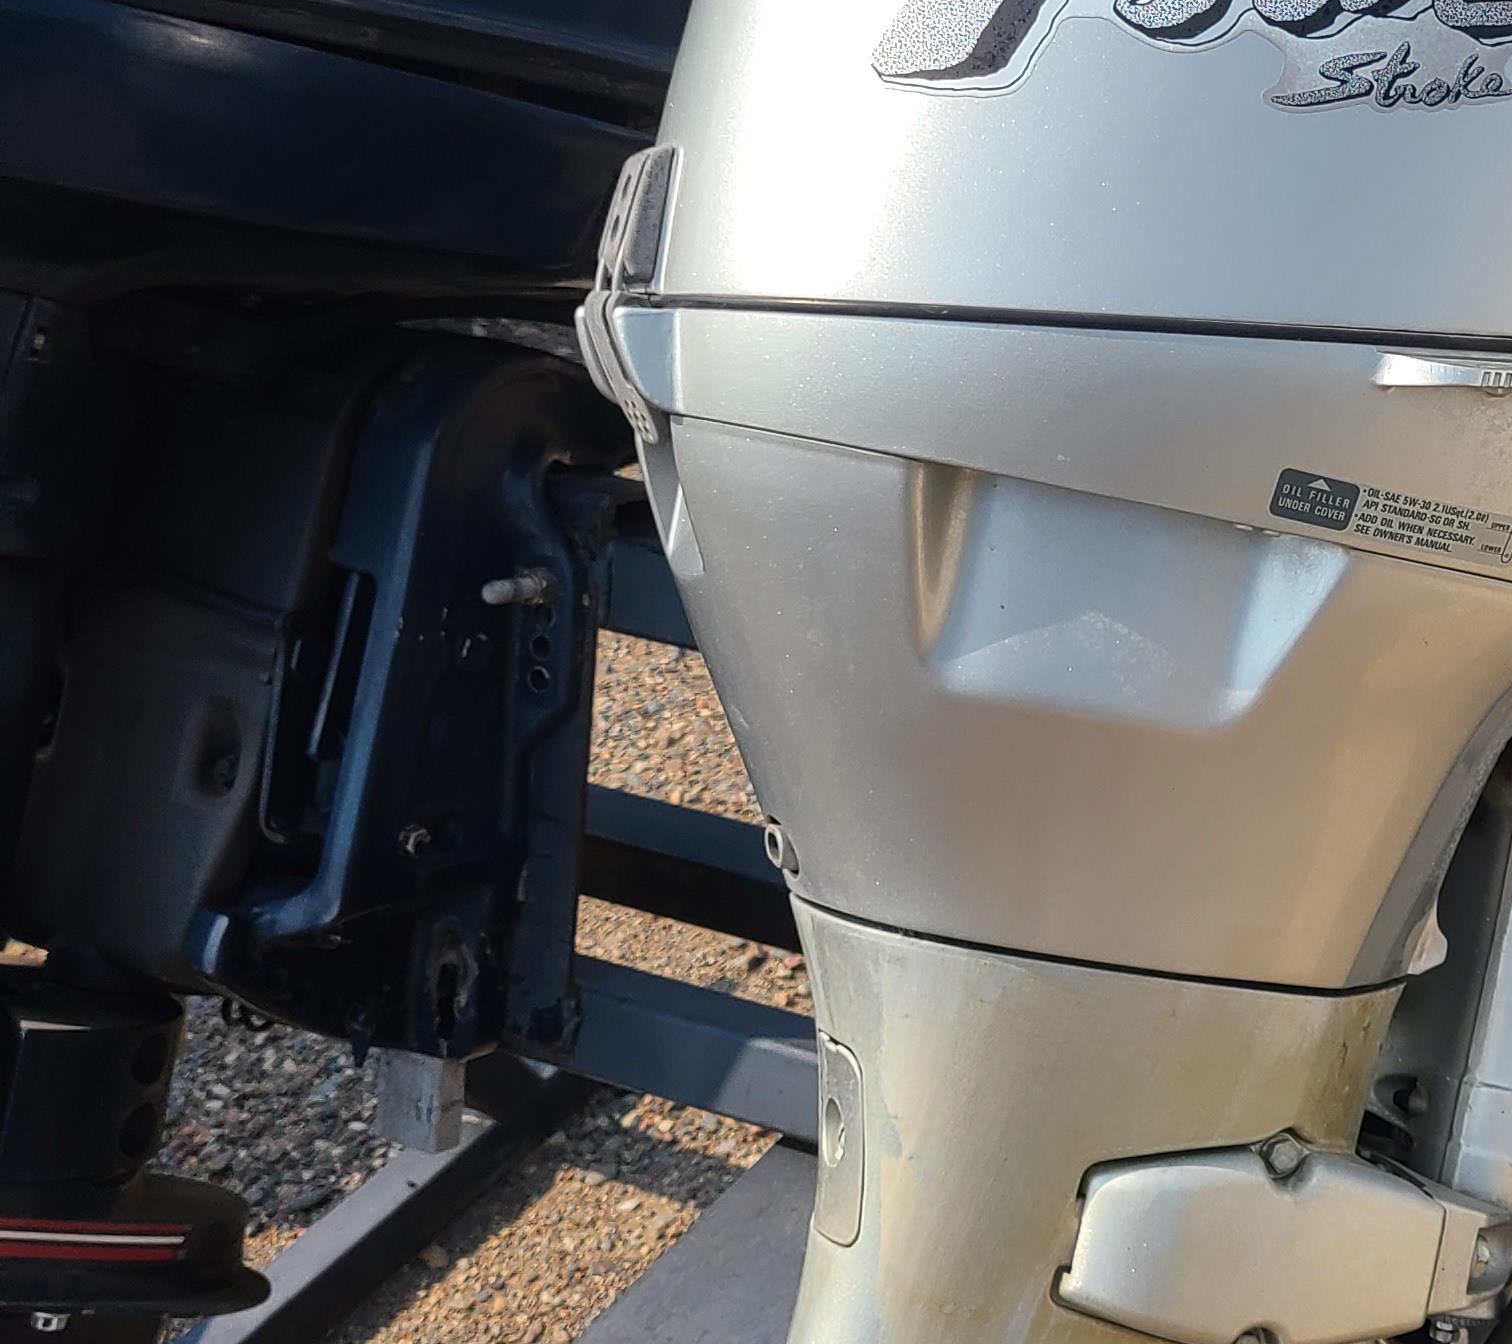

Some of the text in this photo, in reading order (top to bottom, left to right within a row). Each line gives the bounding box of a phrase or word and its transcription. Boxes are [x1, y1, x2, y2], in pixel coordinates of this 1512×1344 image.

[1282, 484, 1350, 509] OIL FILLER
[1402, 496, 1432, 510] 5W-30
[1278, 497, 1346, 521] UNDER COVER
[1362, 499, 1379, 511] API
[1443, 517, 1455, 527] OR
[1354, 523, 1452, 552] SEE OWNER'S MANUAL
[1358, 512, 1476, 546] ADD OIL WHEN NECESSARY.
[1491, 522, 1511, 531] UPPER
[1480, 543, 1502, 553] LOWER
